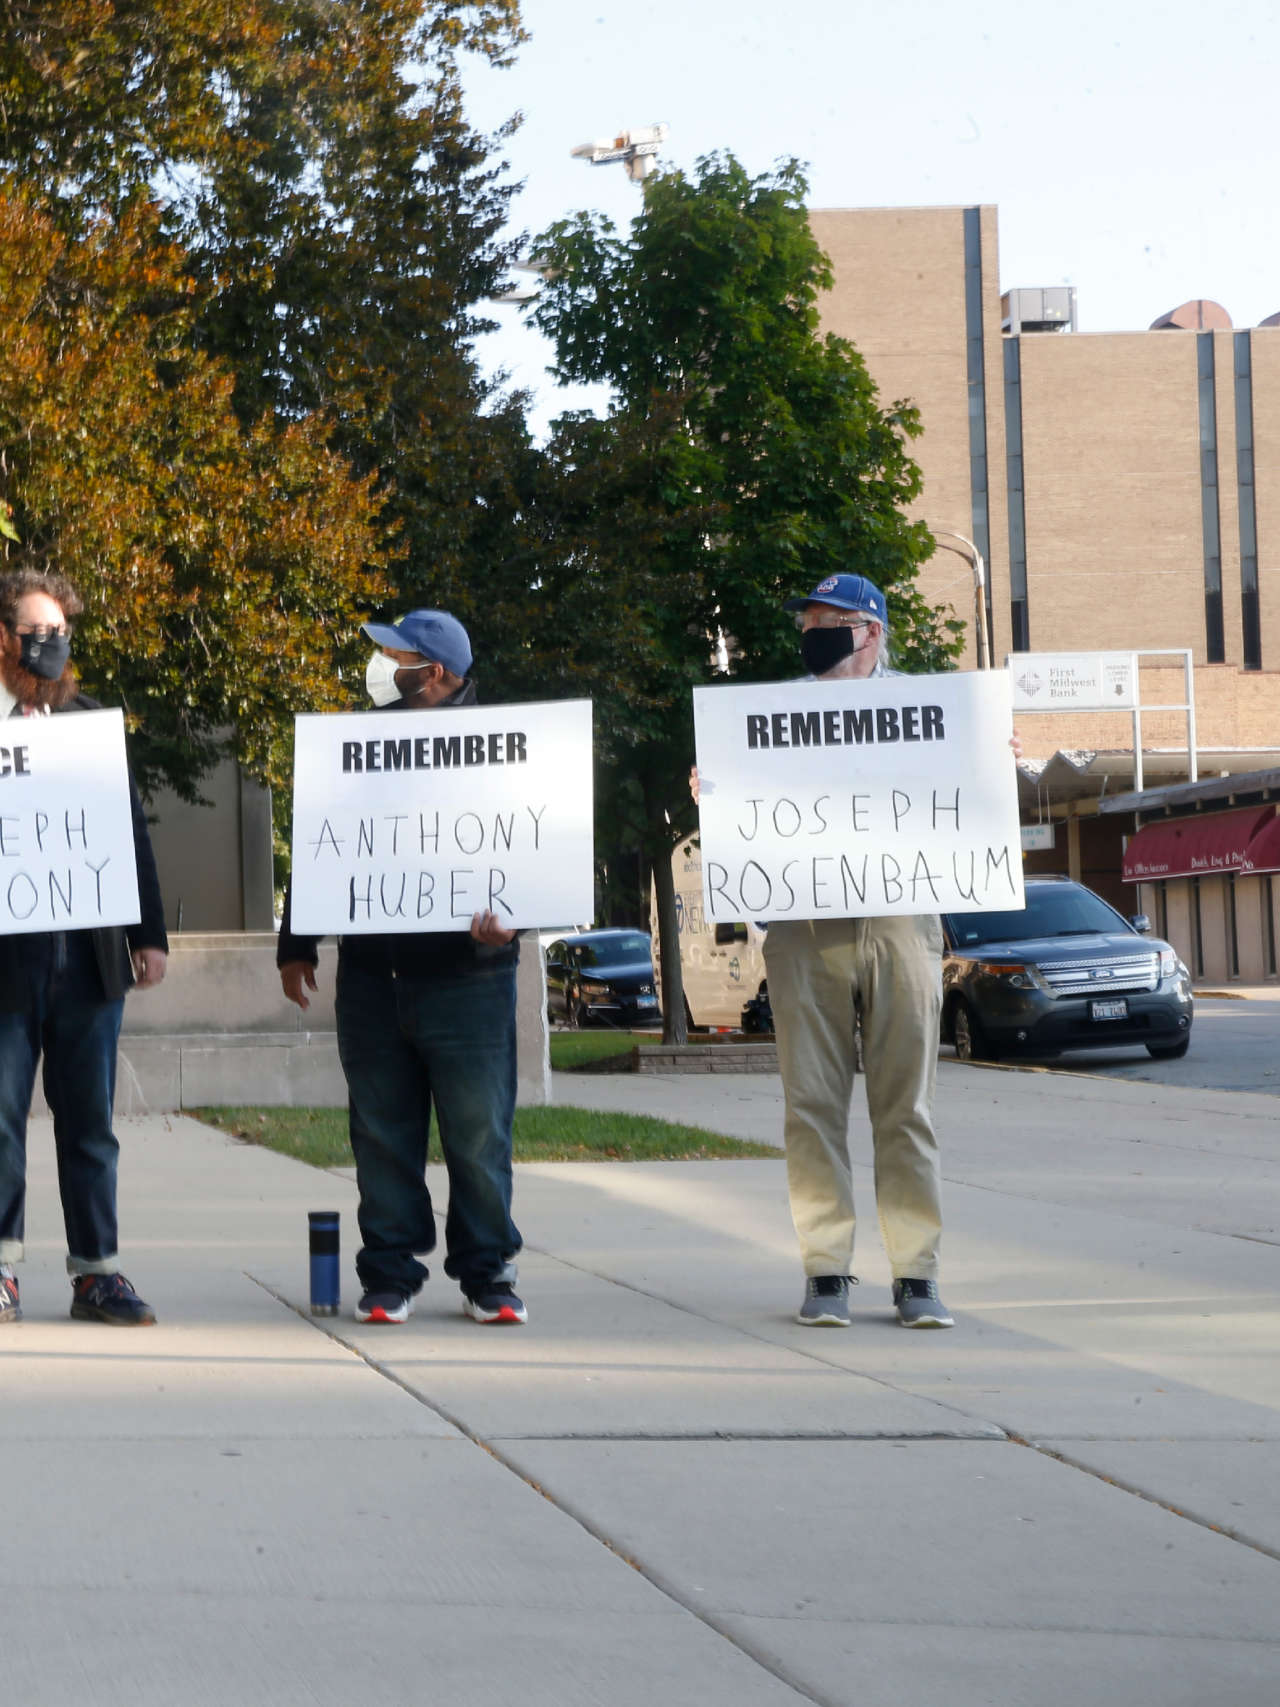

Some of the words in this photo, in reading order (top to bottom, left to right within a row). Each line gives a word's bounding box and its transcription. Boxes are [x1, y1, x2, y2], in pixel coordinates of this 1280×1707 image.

[1049, 667, 1075, 677] First
[1049, 678, 1096, 687] Midwest
[1049, 688, 1078, 697] Bank
[747, 705, 945, 750] REMEMBER
[342, 731, 527, 773] REMEMBER
[308, 804, 546, 860] ANTHONY
[738, 787, 960, 841] JOSEPH
[349, 868, 513, 922] HUBER
[707, 846, 1016, 916] ROSENBAUM
